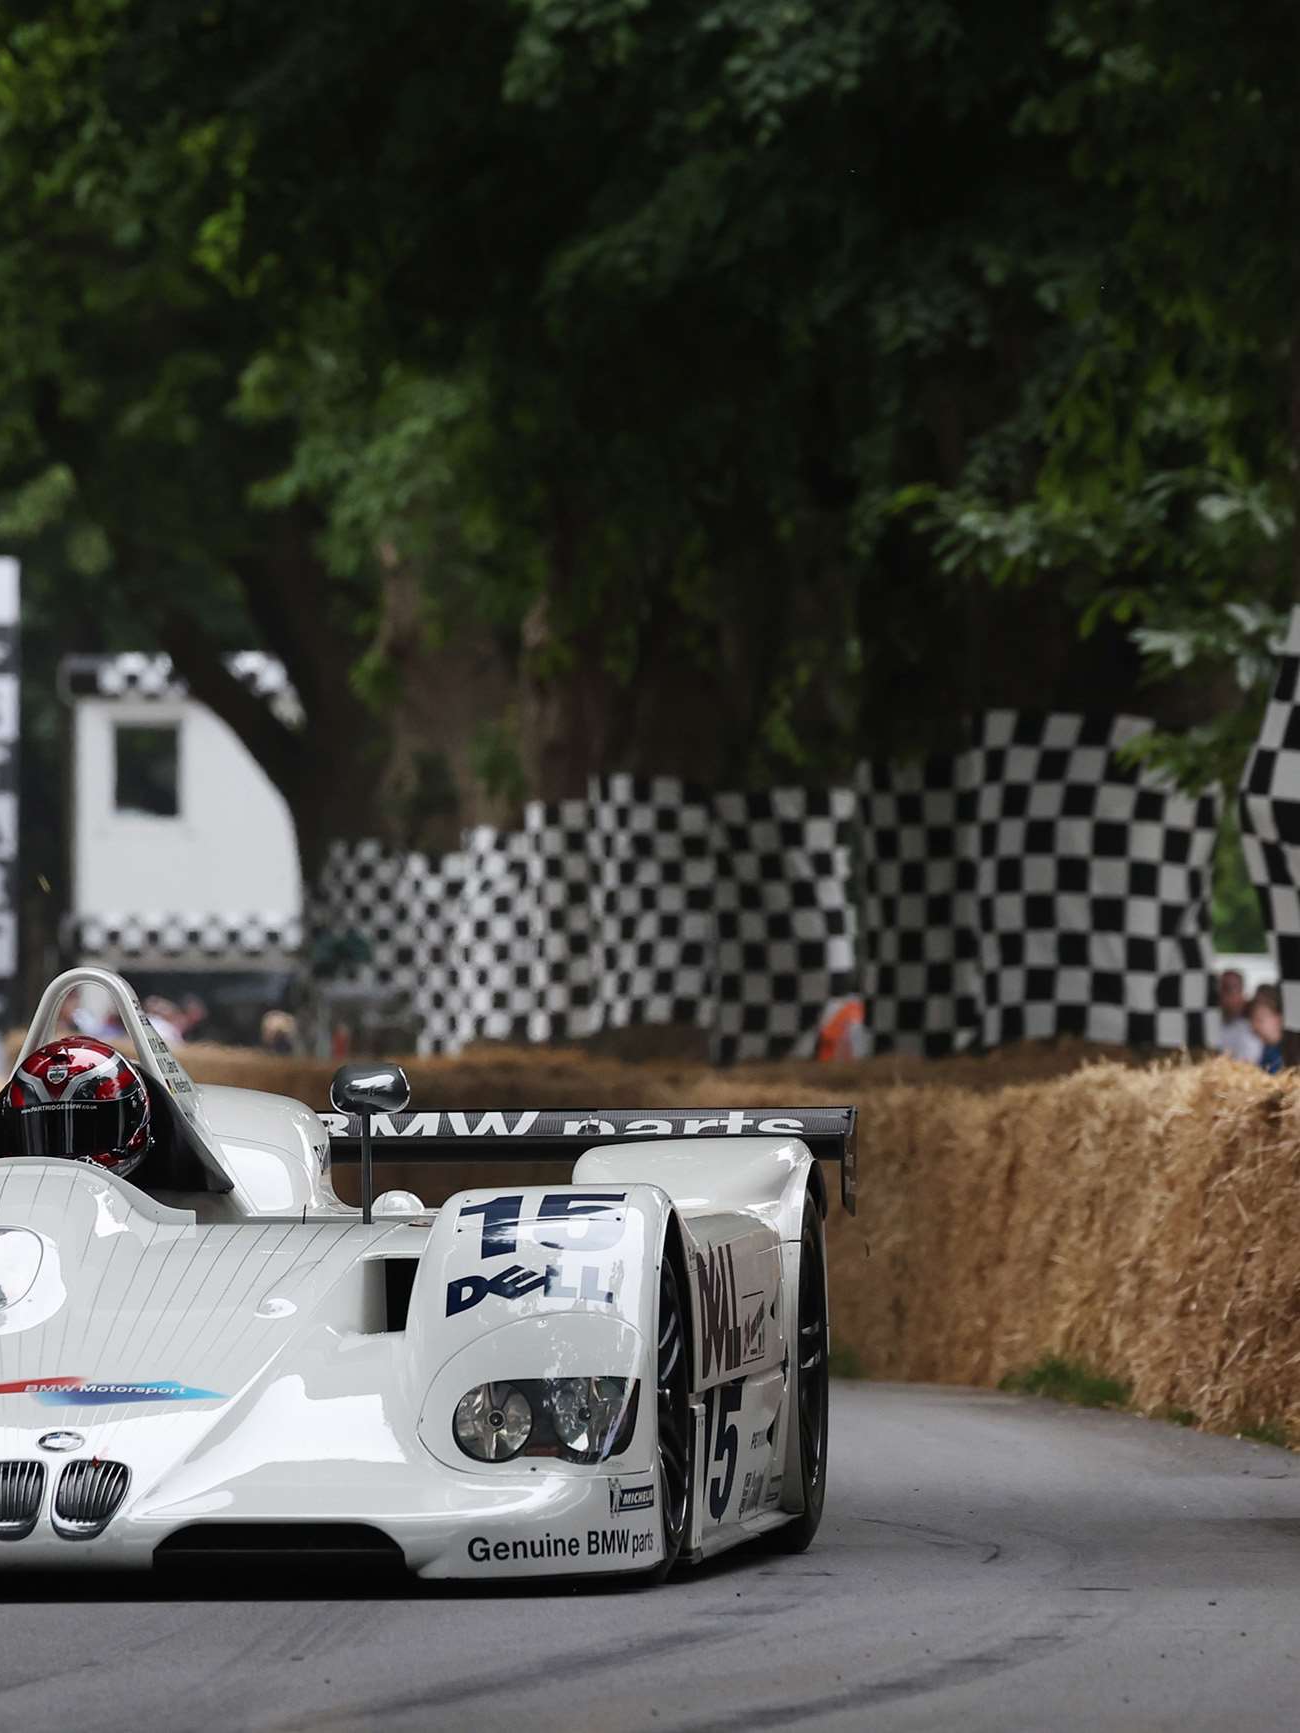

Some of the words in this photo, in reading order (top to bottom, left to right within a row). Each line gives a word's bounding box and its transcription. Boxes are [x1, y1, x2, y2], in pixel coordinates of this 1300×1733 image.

[459, 1192, 628, 1259] 15
[446, 1264, 613, 1318] DELL
[25, 1383, 75, 1393] BMW
[78, 1383, 186, 1395] Motorsport
[467, 1532, 580, 1562] Genuine
[587, 1529, 630, 1555] BMW
[632, 1527, 654, 1559] parts
